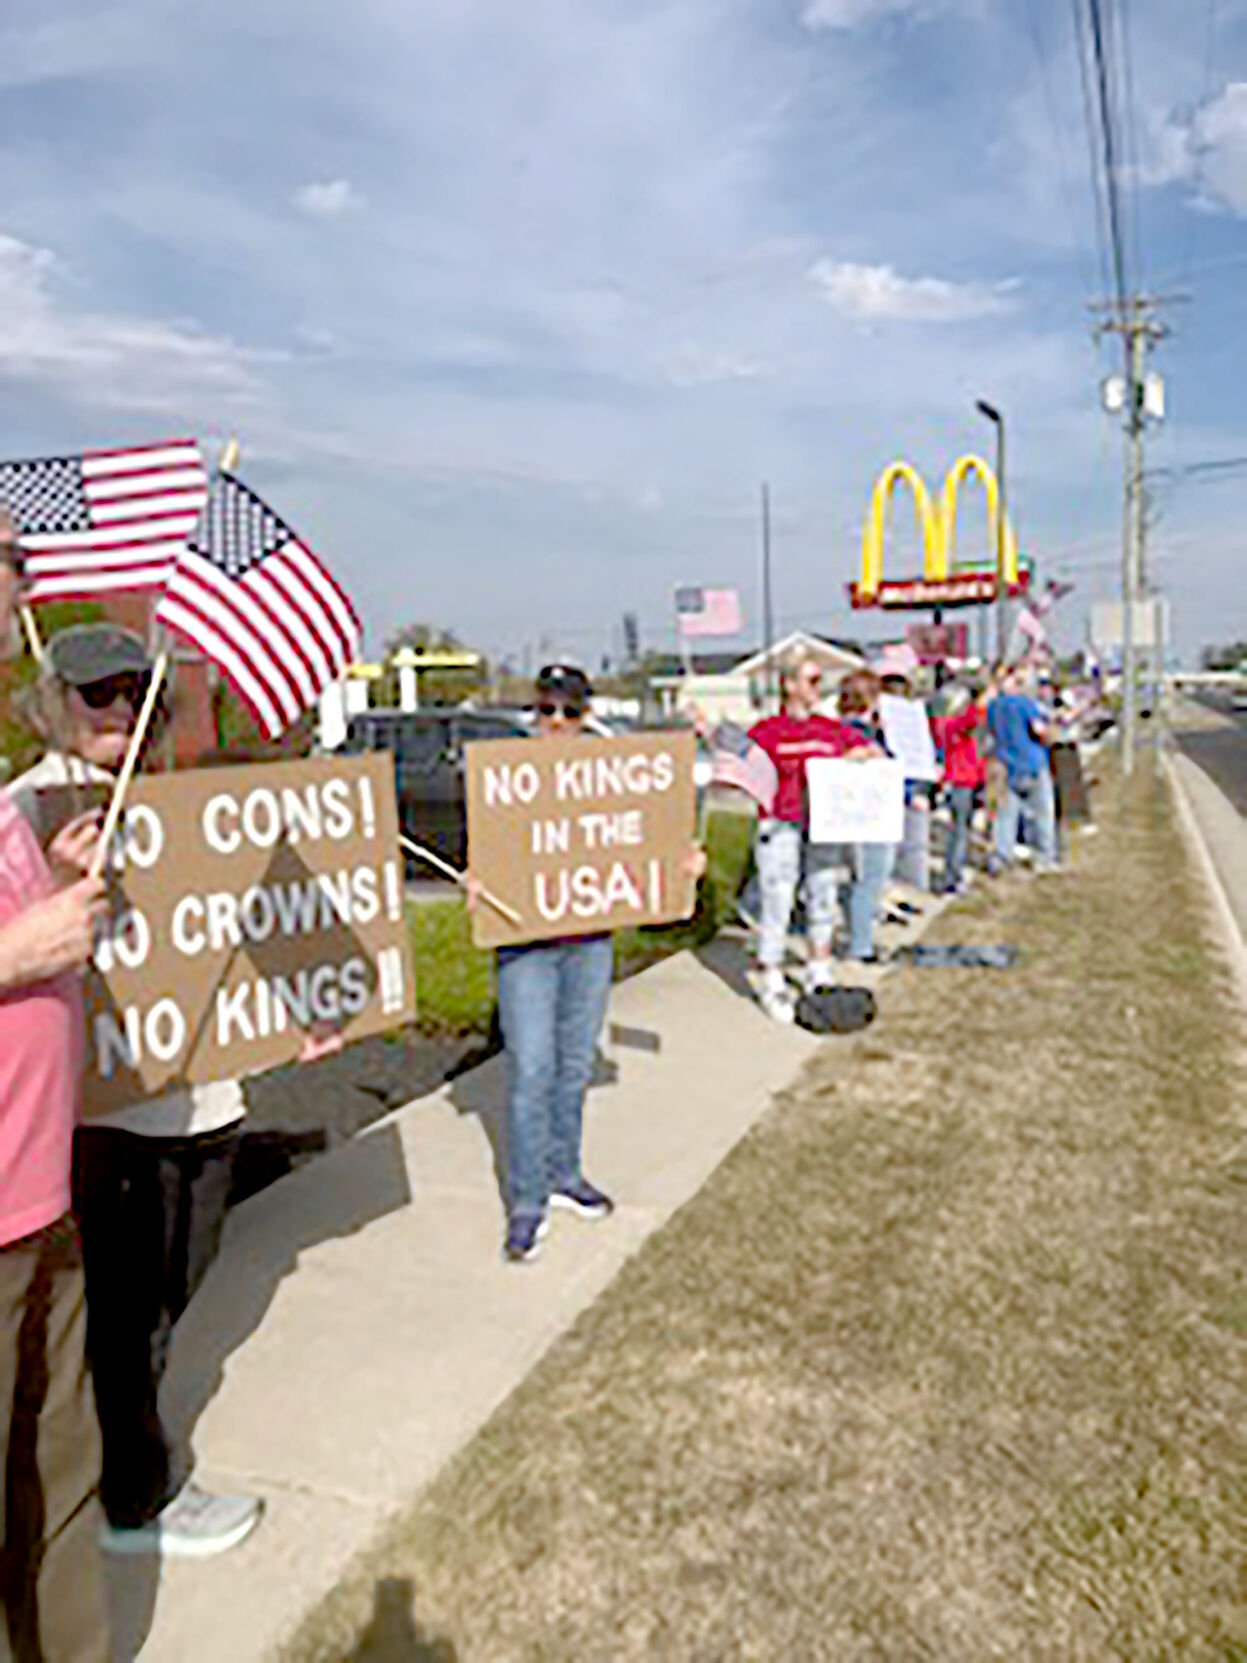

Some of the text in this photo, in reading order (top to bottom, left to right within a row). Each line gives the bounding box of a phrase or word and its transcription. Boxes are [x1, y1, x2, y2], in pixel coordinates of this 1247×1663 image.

[202, 777, 375, 853] CONS!
[483, 752, 674, 804] NO KINGS
[531, 810, 643, 854] IN THE
[94, 861, 400, 971] O CROWNS!
[94, 997, 185, 1080] NO
